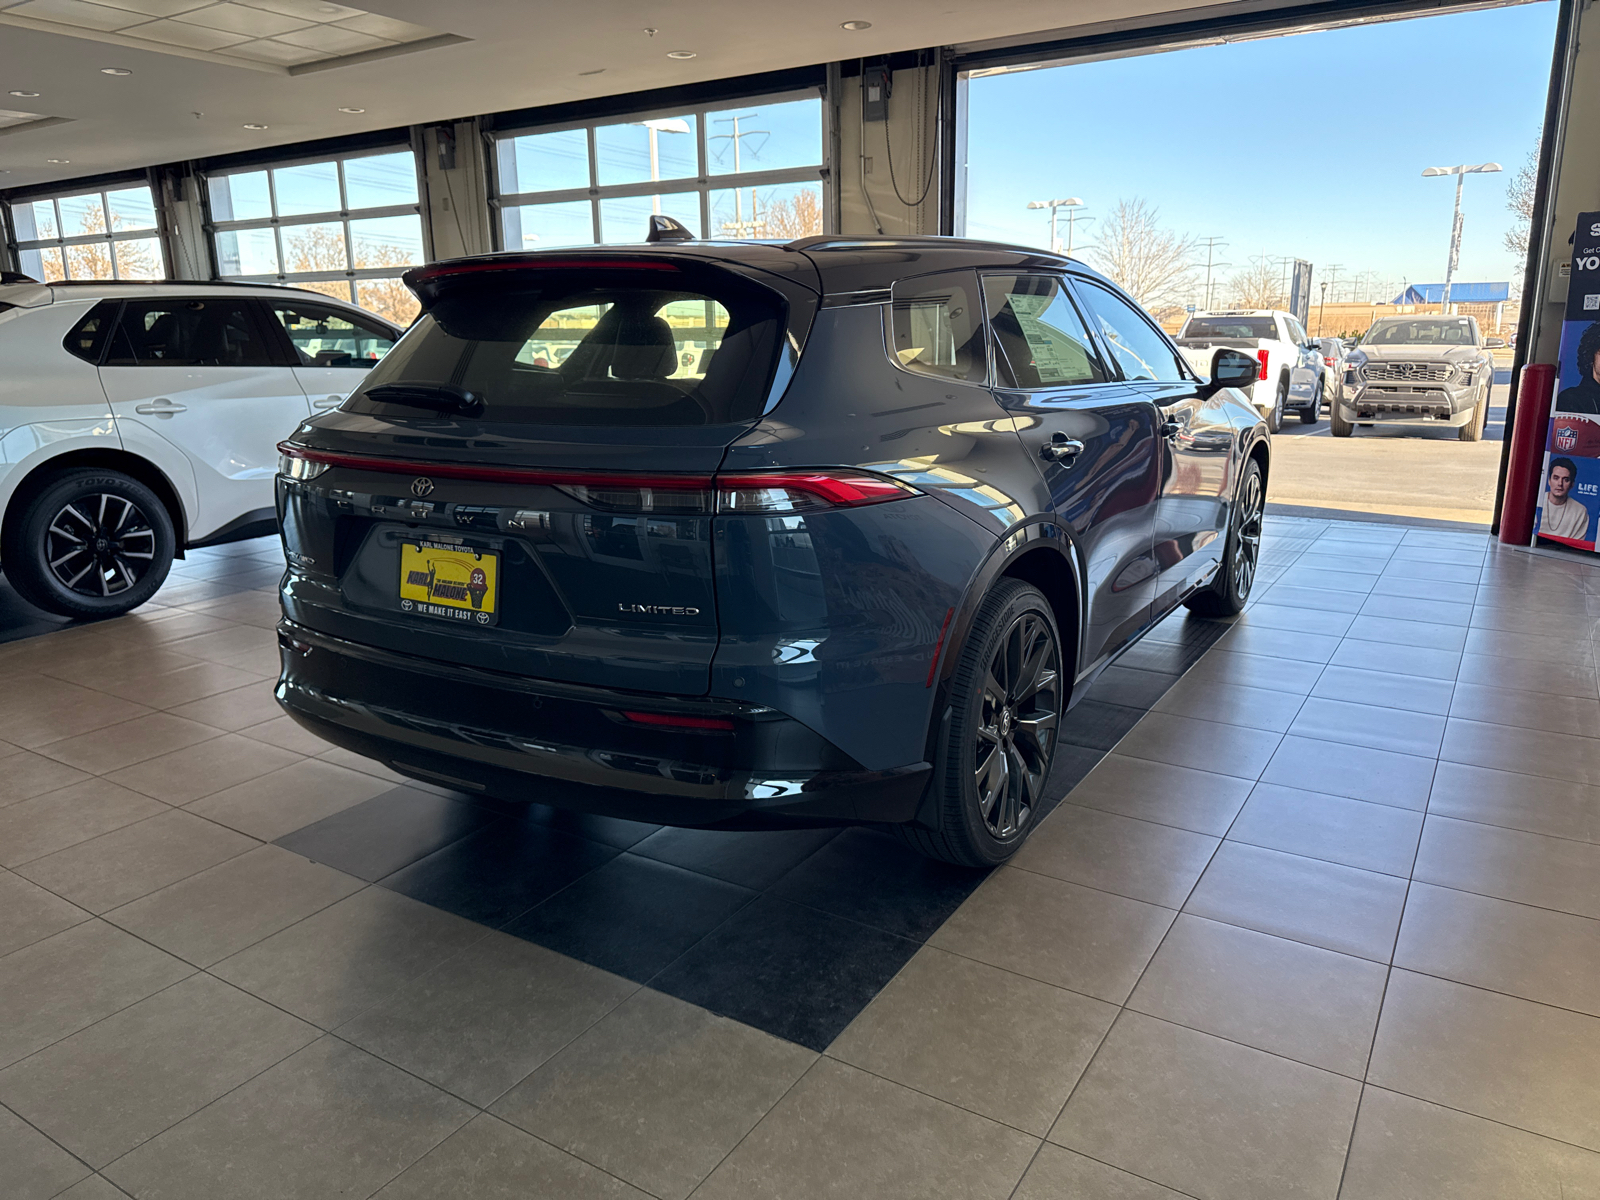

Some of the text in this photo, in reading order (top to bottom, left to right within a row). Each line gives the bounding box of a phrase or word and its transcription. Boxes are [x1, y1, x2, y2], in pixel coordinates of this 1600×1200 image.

[1557, 437, 1575, 449] NFL
[75, 478, 116, 488] TOYO
[1577, 482, 1598, 492] LIFE
[433, 543, 453, 551] MALONE
[406, 571, 429, 586] KARL
[473, 573, 484, 585] 32
[433, 583, 468, 601] MALONE
[417, 604, 471, 620] WE MAKE IT EASY
[619, 603, 700, 616] LIMITED
[979, 603, 1015, 673] BRIDGESTONE
